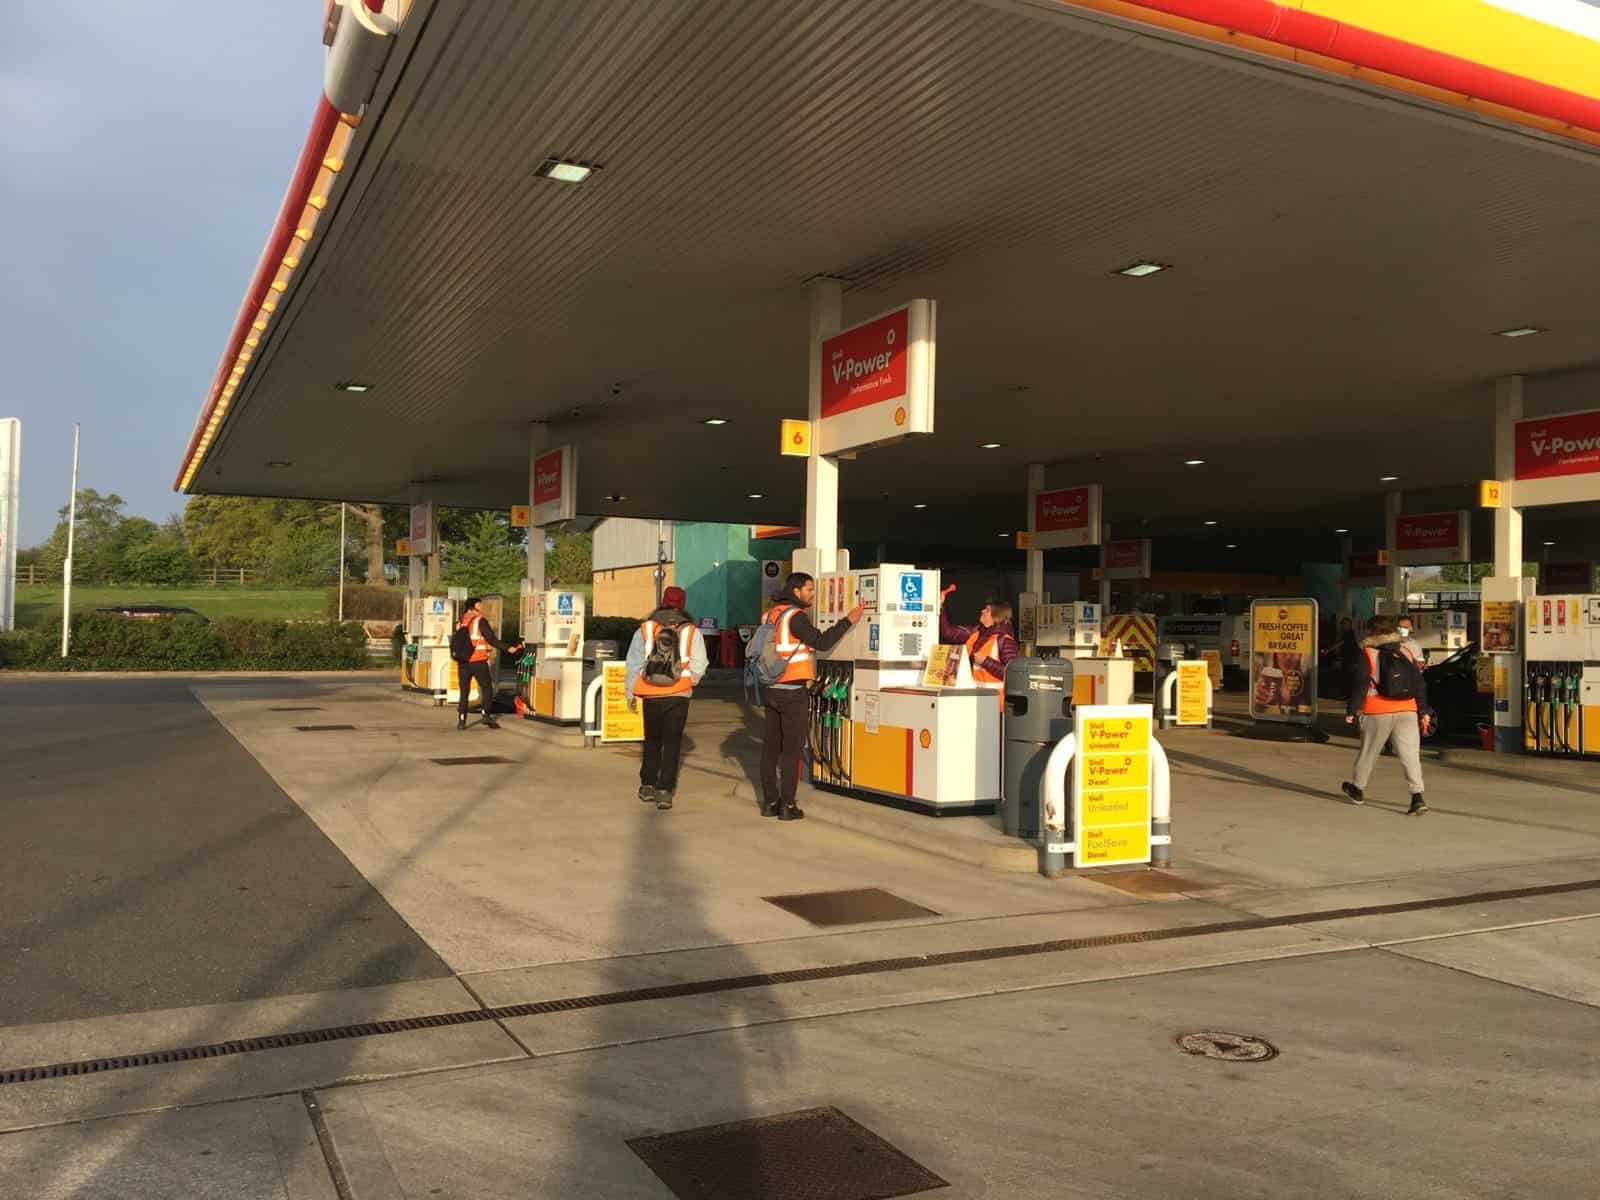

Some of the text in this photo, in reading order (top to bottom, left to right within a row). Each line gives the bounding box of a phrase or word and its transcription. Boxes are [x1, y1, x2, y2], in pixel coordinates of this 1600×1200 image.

[832, 352, 892, 384] V-Power
[793, 432, 802, 445] 6
[1489, 488, 1499, 498] 12
[1258, 623, 1308, 631] FRESH COFFEE
[1268, 641, 1296, 649] BREAKS
[1089, 730, 1129, 739] V-Power
[1089, 767, 1128, 776] V-Power
[1088, 778, 1108, 786] Diesel
